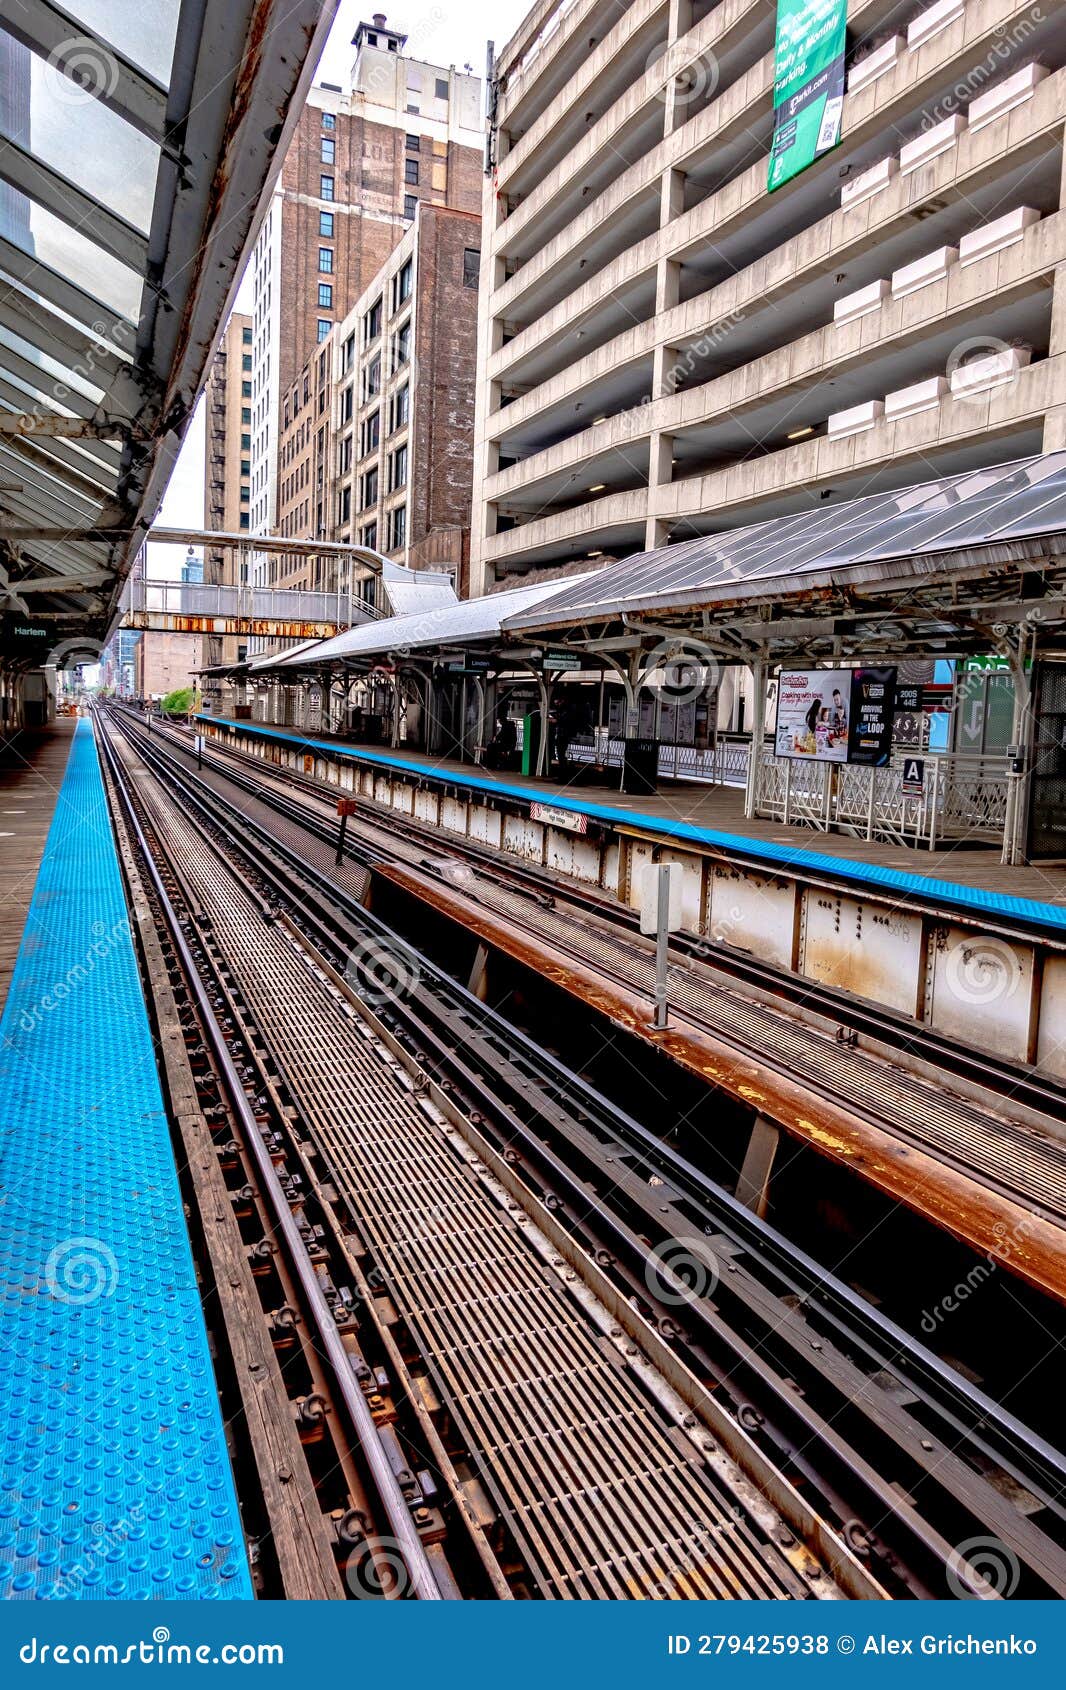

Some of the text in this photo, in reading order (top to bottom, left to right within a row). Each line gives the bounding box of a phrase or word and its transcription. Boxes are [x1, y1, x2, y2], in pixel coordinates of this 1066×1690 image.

[14, 627, 47, 637] Harlem
[900, 690, 918, 698] 200S
[903, 699, 918, 707] 44E
[870, 714, 879, 722] THE
[867, 723, 885, 734] LOOP
[906, 761, 920, 780] A
